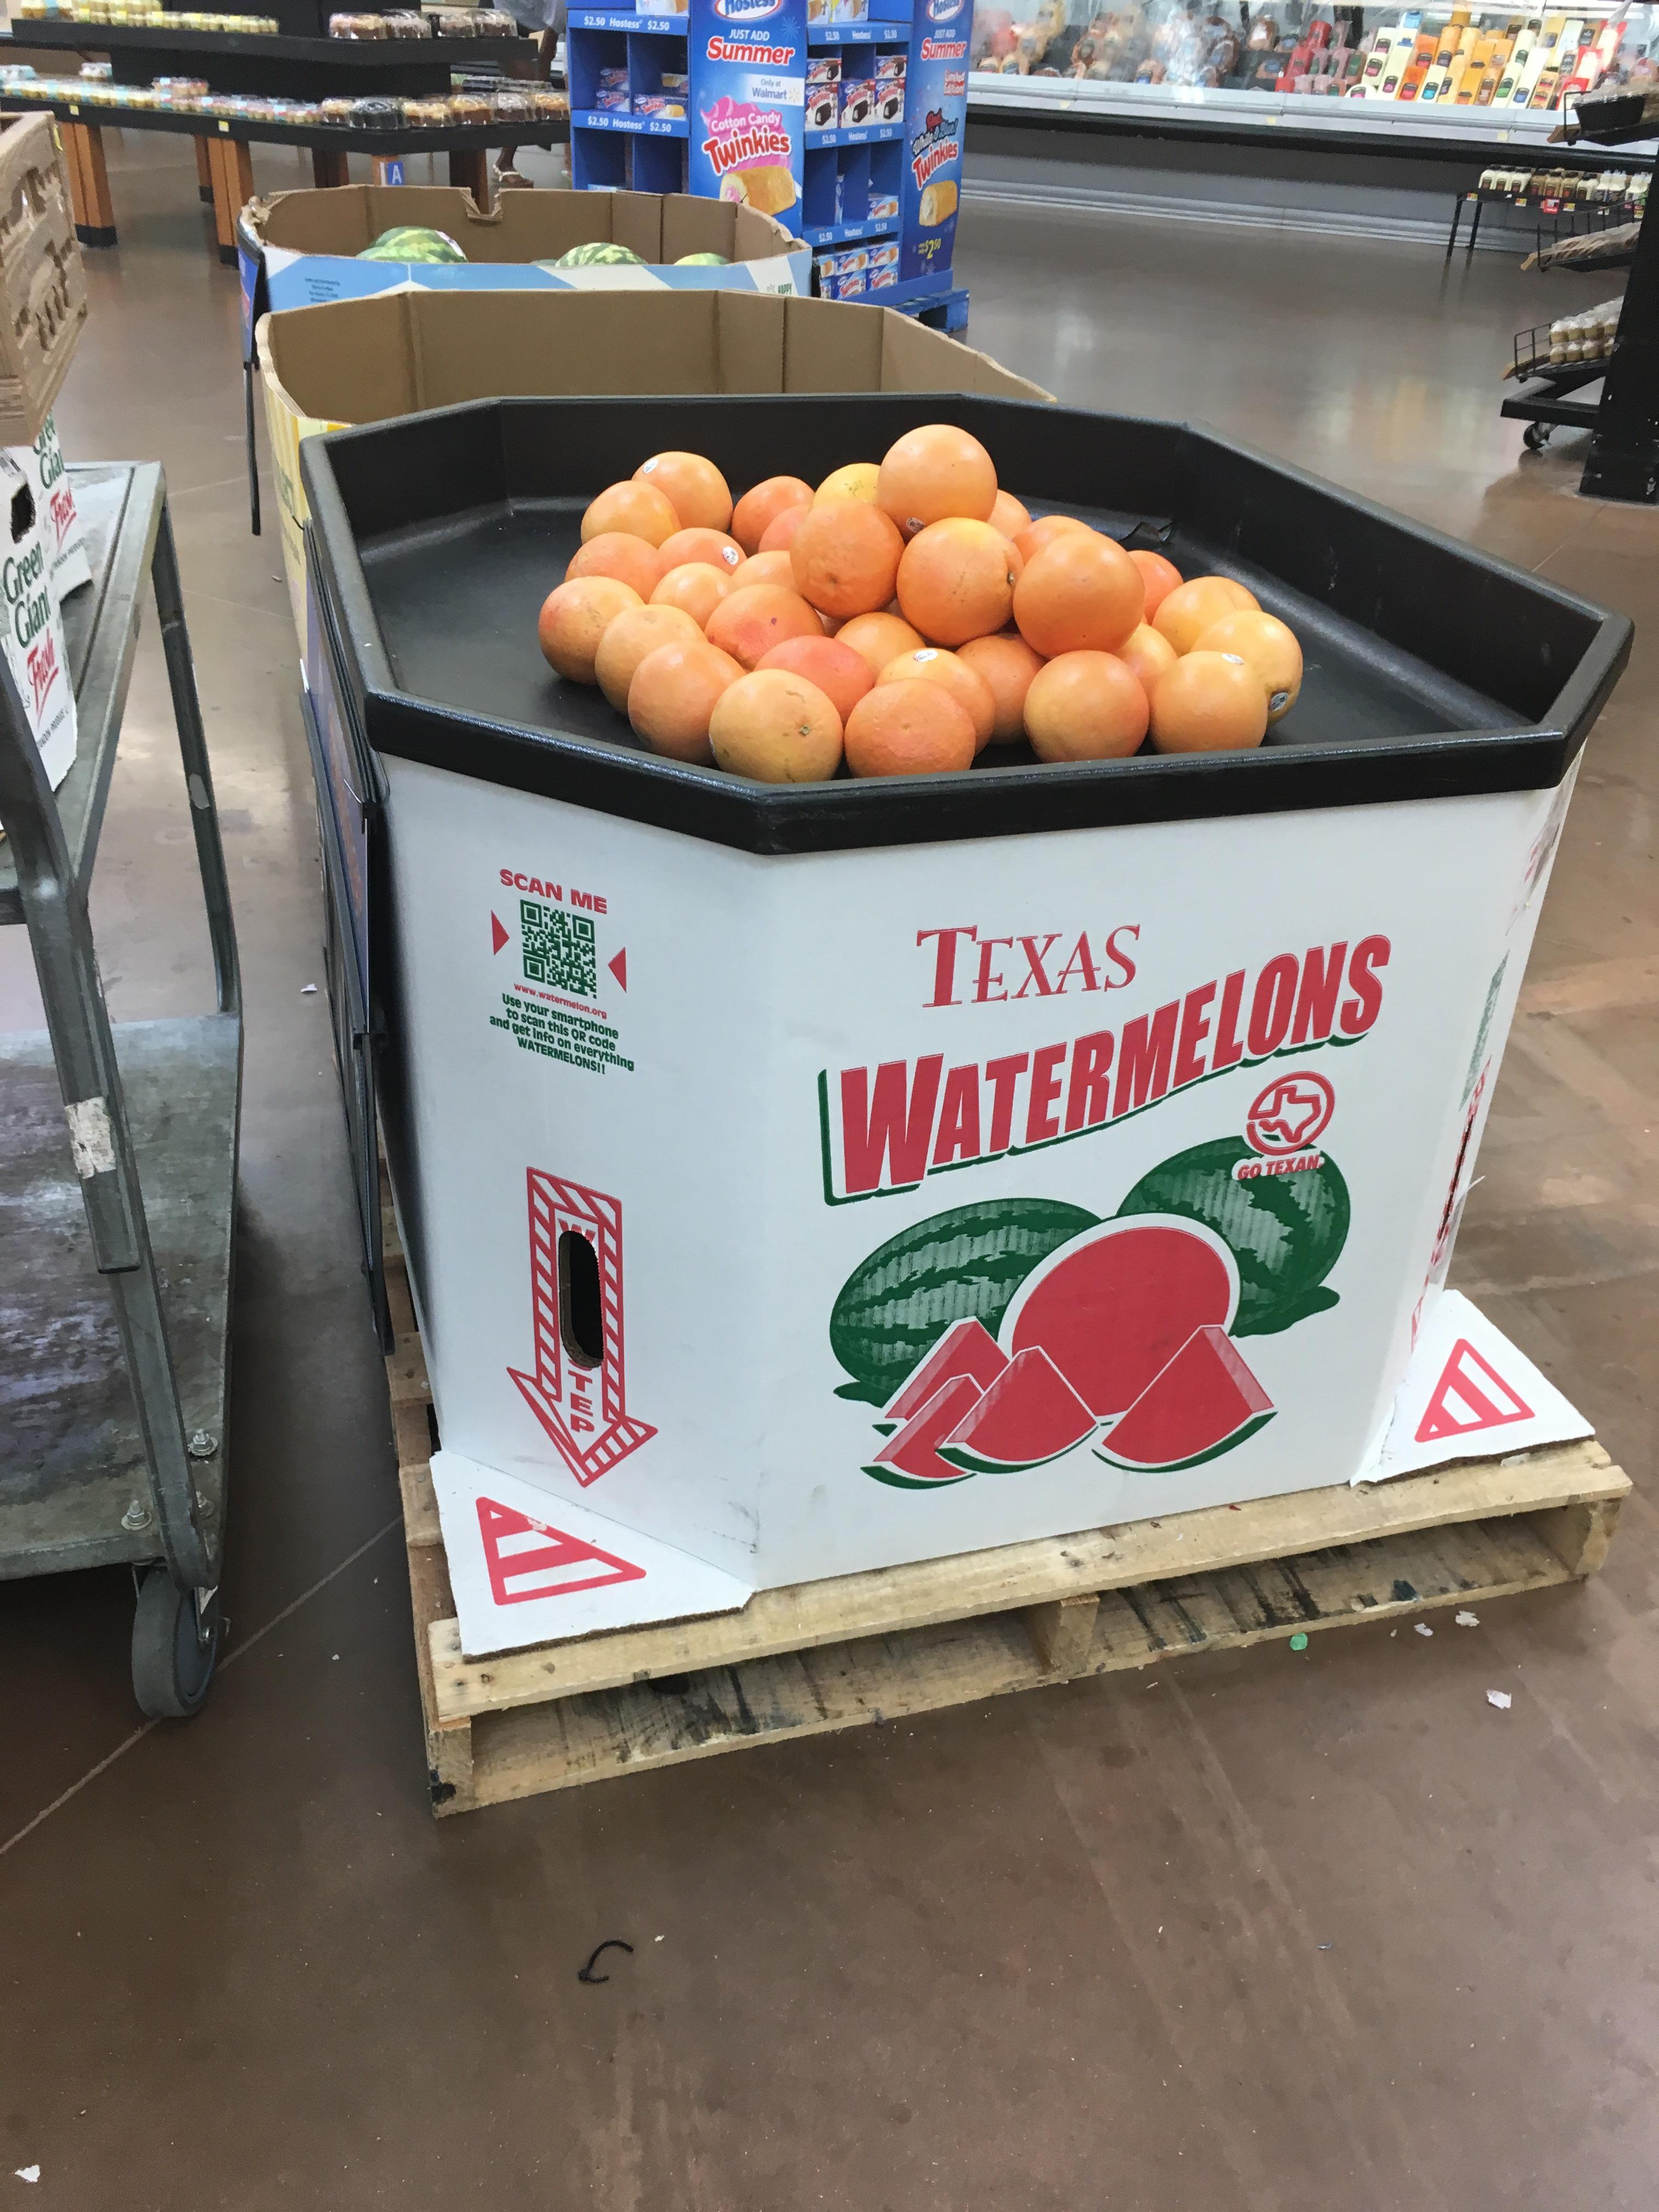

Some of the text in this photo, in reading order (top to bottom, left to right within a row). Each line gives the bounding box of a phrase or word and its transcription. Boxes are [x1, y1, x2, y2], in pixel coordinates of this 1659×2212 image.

[584, 15, 606, 26] $2.50
[647, 20, 670, 31] $2.50
[729, 29, 770, 41] JUST ADD
[706, 36, 795, 66] Summer
[921, 37, 967, 60] Summer
[752, 87, 787, 100] Walmart
[760, 78, 775, 87] Only
[588, 116, 609, 126] $2.50
[650, 121, 672, 133] $2.50
[711, 112, 781, 132] Cotton Candy
[702, 126, 791, 175] Twinkies
[912, 138, 958, 190] Twinkies
[3, 540, 44, 604] Green
[15, 584, 52, 649] Giant
[500, 868, 607, 915] SCAN ME
[916, 924, 1141, 1008] TEXAS
[502, 992, 619, 1040] Use your smartphone
[514, 984, 607, 1019] www.watermelon.org
[489, 1015, 635, 1071] and get info on everything
[506, 1007, 616, 1051] to scan this QR code
[517, 1036, 606, 1075] WATERMELONS!!
[839, 934, 1392, 1194] WATERMELONS
[1237, 1155, 1321, 1181] GO TEXAN
[567, 1358, 595, 1432] TEP
